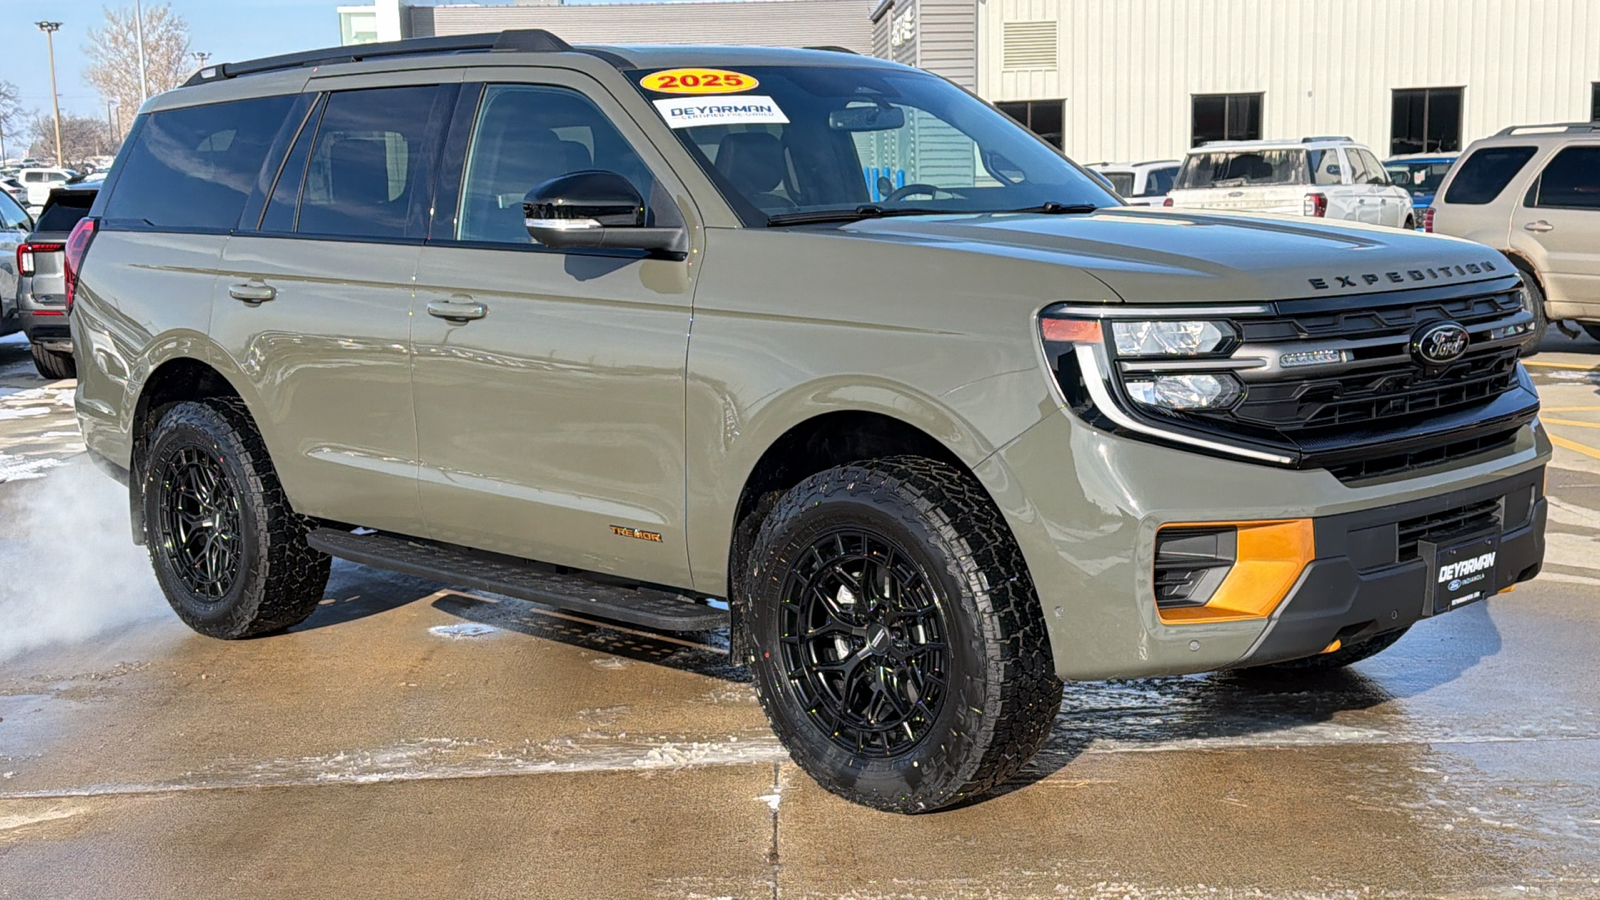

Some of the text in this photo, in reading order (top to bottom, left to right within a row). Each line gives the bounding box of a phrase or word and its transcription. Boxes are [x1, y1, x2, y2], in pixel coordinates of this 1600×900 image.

[657, 74, 744, 89] 2025
[670, 105, 772, 117] DEYARMAN
[681, 112, 725, 120] CERTIFIED
[1308, 261, 1497, 290] EXPEDITION
[1429, 330, 1465, 358] Ford
[609, 525, 663, 542] TREMOR
[1438, 551, 1497, 583] DEYARMAN
